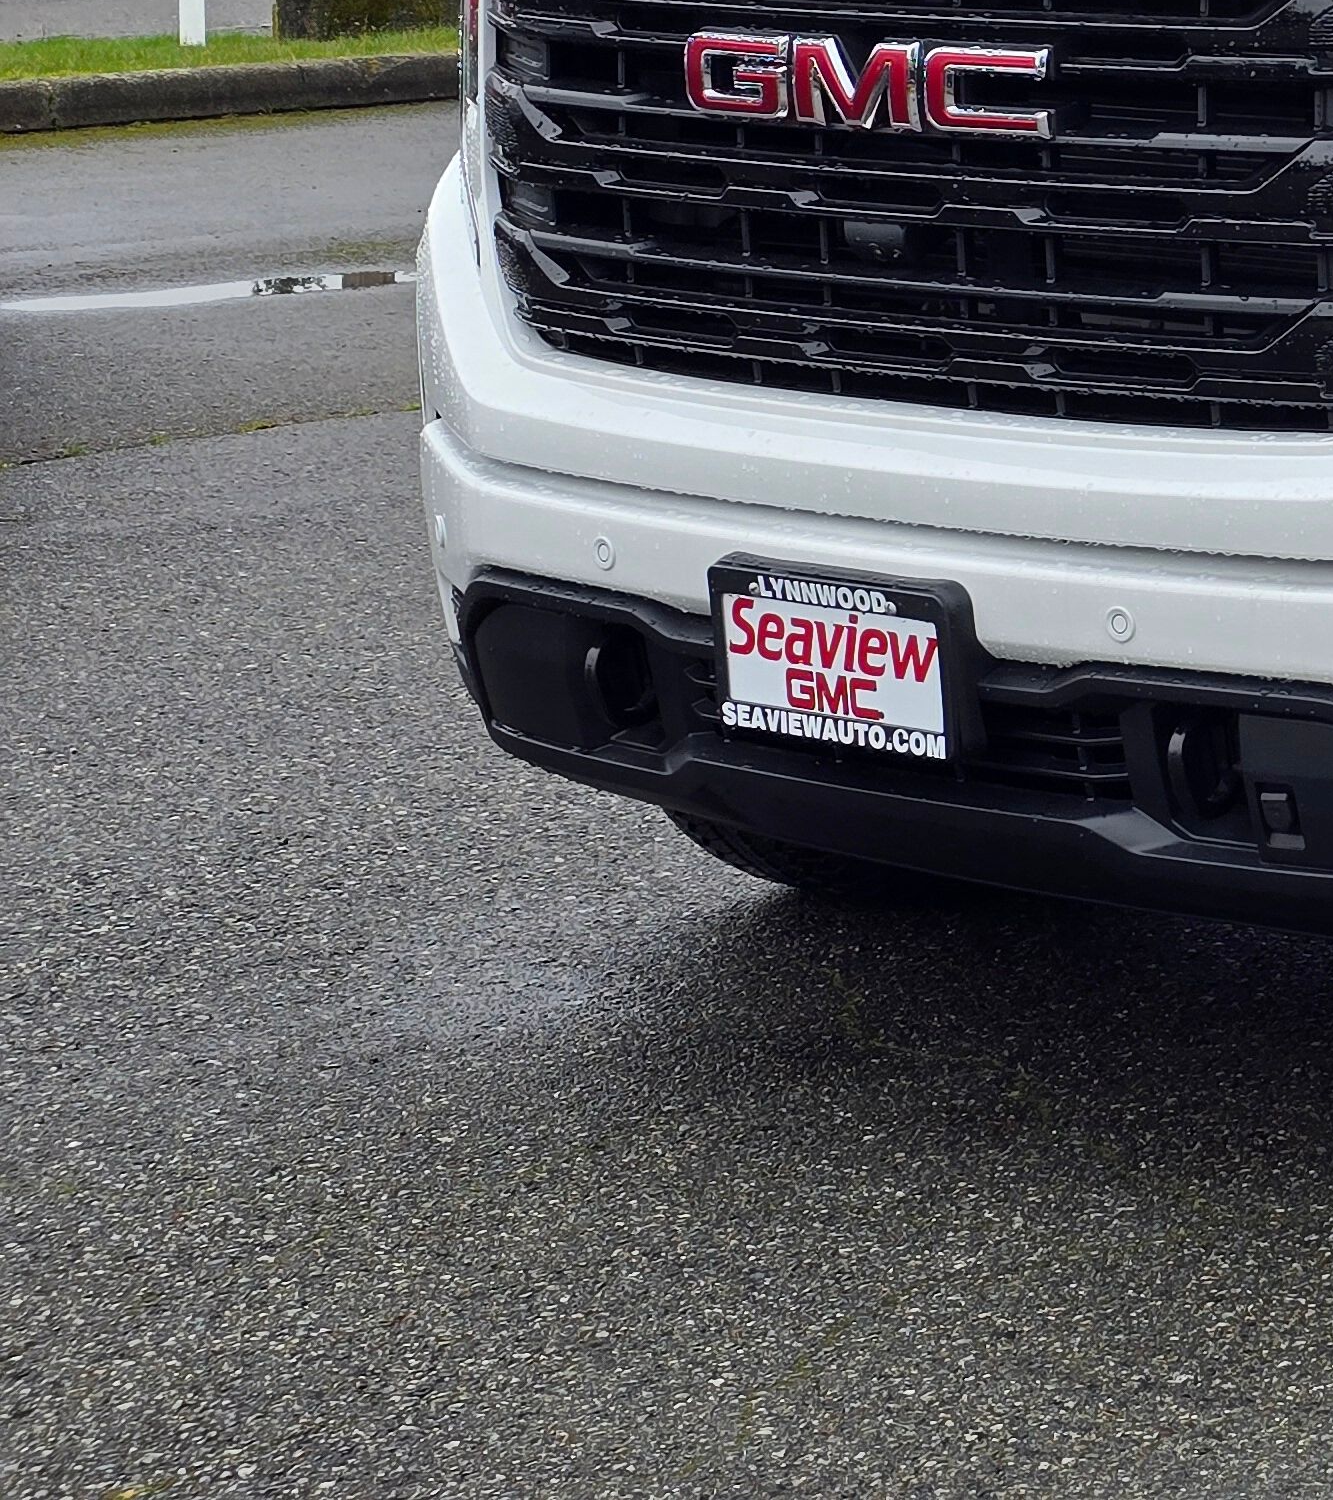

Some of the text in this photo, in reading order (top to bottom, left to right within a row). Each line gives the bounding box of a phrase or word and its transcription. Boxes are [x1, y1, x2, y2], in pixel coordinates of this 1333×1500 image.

[684, 30, 1054, 140] GMC
[757, 575, 887, 613] LYNNWOOD
[729, 597, 938, 683] Seaview
[785, 667, 885, 720] GMC
[721, 701, 947, 760] SEAVIEWAUTO.COM
